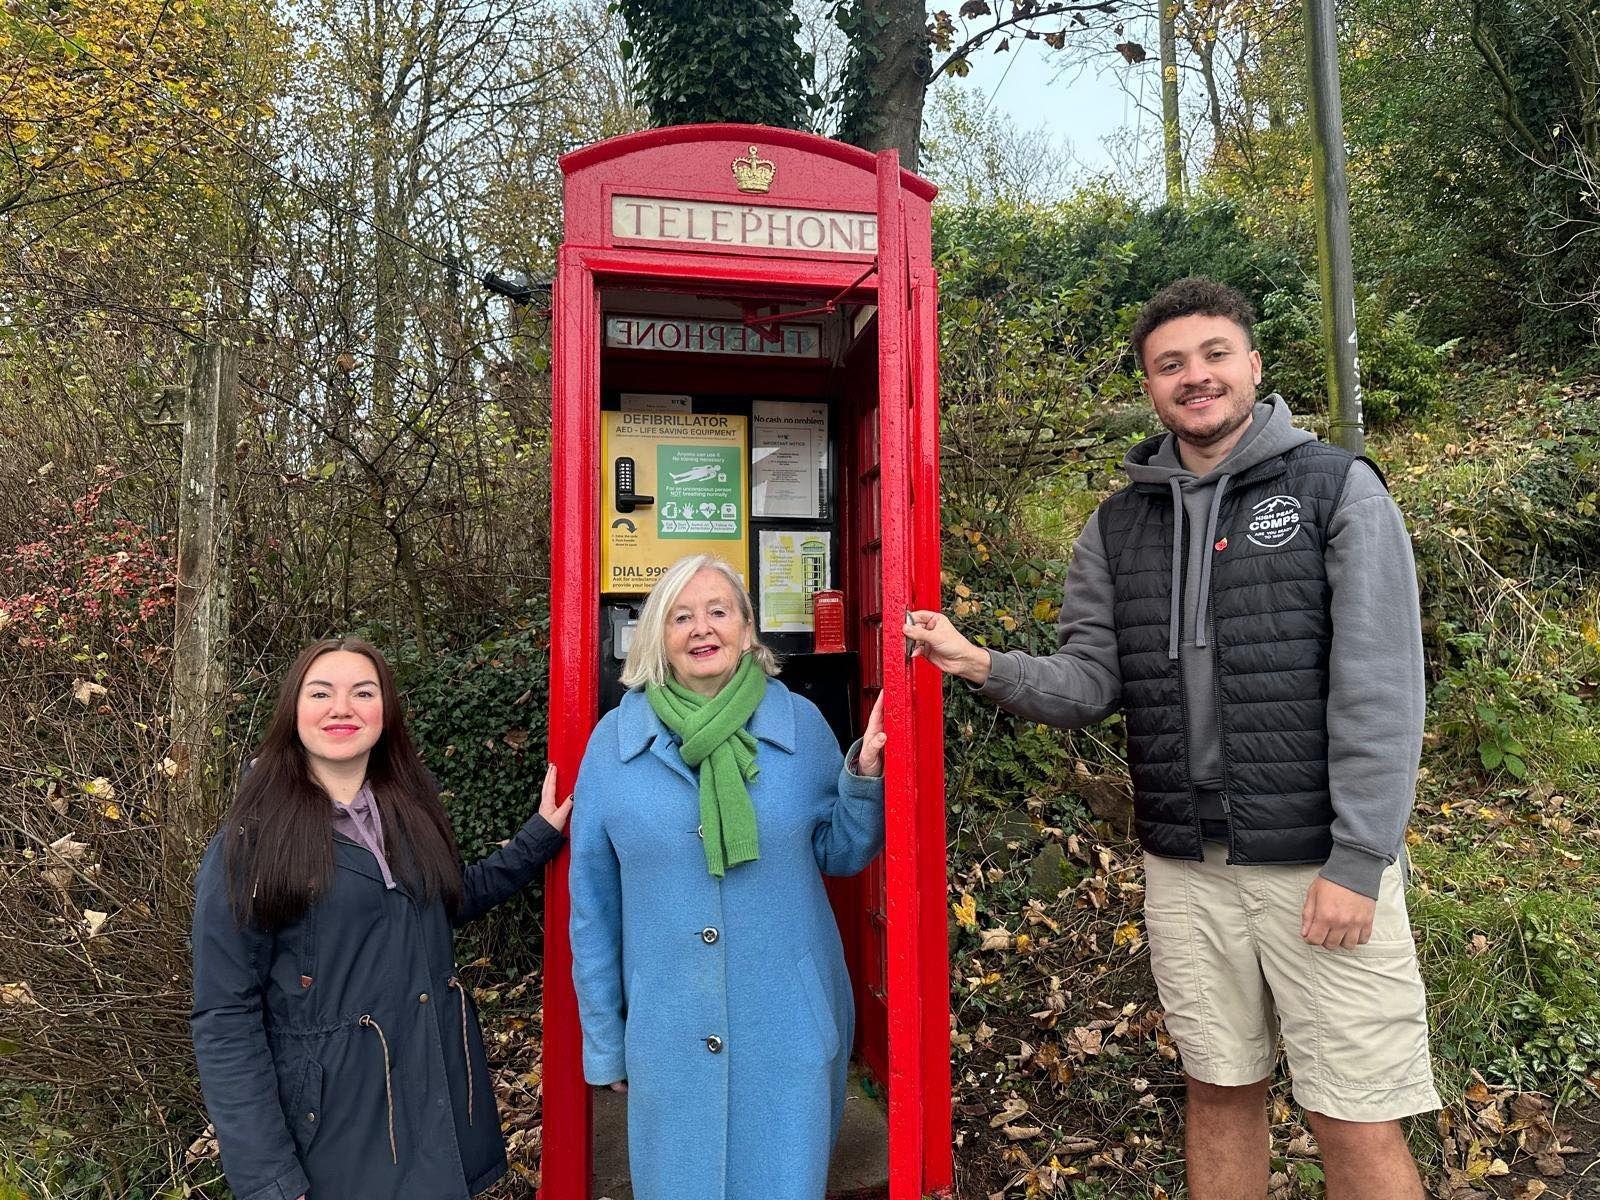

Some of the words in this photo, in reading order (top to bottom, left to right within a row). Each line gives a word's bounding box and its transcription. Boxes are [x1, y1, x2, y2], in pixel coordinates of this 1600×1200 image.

[624, 203, 878, 251] TELEPHONE
[623, 413, 729, 428] DEFIBRILLATOR
[754, 415, 765, 424] No
[794, 417, 825, 426] problem
[659, 427, 689, 436] SAVING
[690, 429, 737, 437] EQUIPMENT
[1255, 513, 1275, 521] HIGH
[1276, 508, 1294, 518] PEAK
[1249, 512, 1300, 531] COMPS
[613, 566, 643, 577] DIAL
[646, 566, 668, 577] 999
